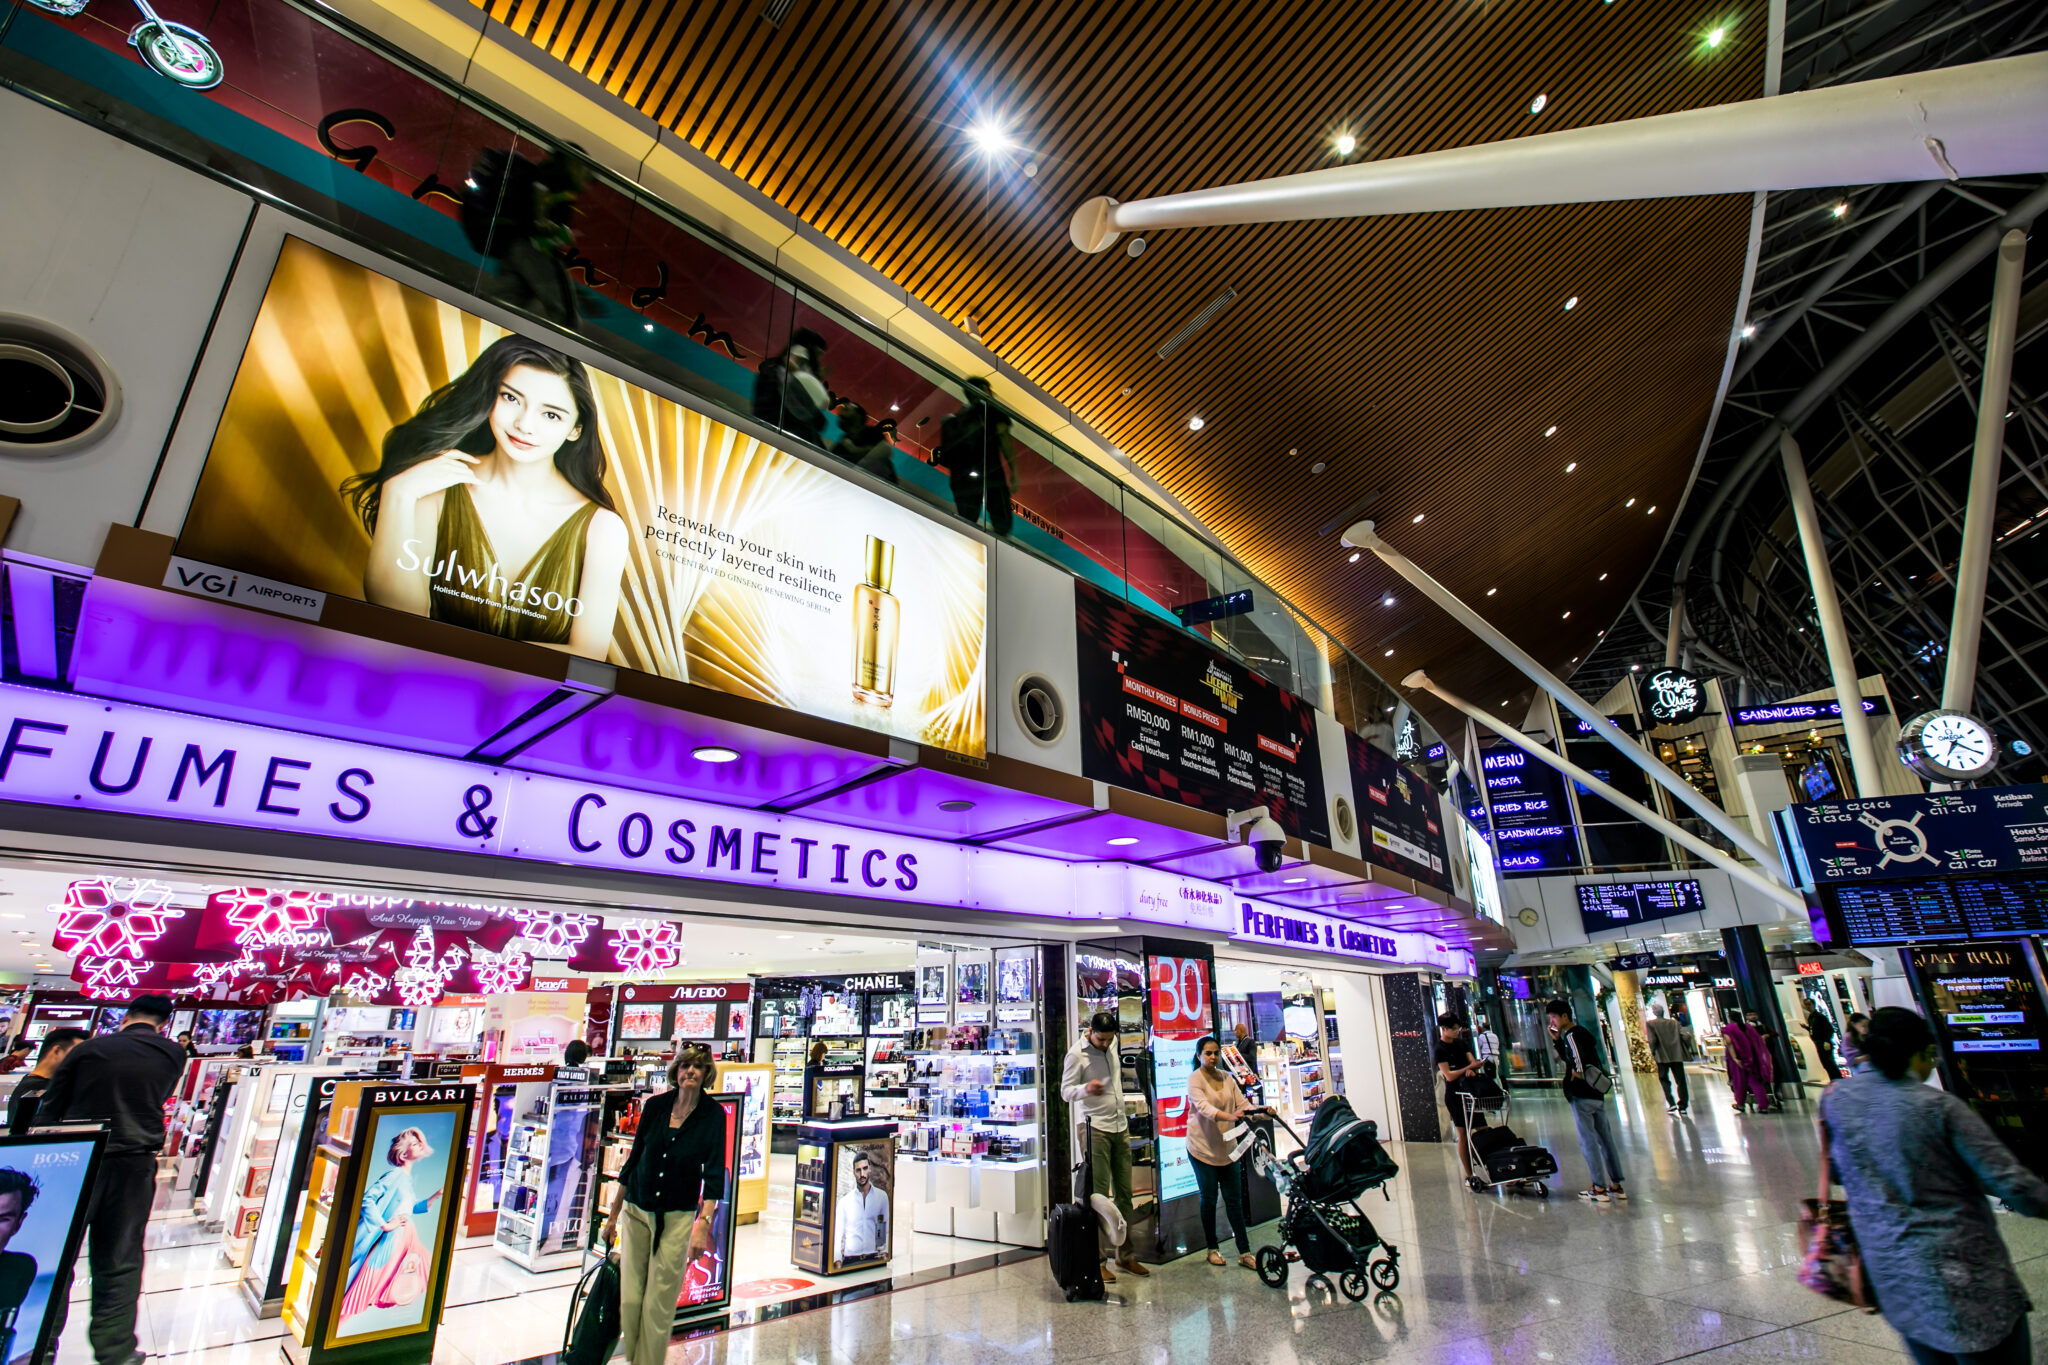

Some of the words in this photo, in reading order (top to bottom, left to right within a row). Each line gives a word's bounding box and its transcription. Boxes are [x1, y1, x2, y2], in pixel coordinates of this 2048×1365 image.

[1023, 507, 1064, 539] Malaysia
[657, 505, 735, 545] Reawaken
[740, 538, 773, 558] your
[776, 551, 804, 570] skin
[809, 564, 836, 583] with
[645, 524, 717, 560] perfectly
[722, 548, 774, 579] layered
[779, 571, 842, 603] resilience
[396, 539, 585, 617] Sulwhasoo
[655, 549, 726, 578] CONCENTRATED
[727, 574, 764, 592] GINSENG
[764, 586, 805, 606] RENEWING
[806, 601, 831, 614] SERUM
[246, 584, 317, 608] AIRPORTS
[433, 584, 460, 598] Holistic
[460, 592, 485, 605] Beauty
[485, 598, 502, 608] from
[502, 603, 521, 614] Asian
[521, 606, 548, 620] Wisdom
[1206, 672, 1234, 693] LICENCE
[1125, 678, 1156, 700] MONTHLY
[1156, 691, 1176, 708] PRIZES
[1220, 690, 1238, 710] WIN
[1126, 704, 1170, 732] RM50,000
[1183, 703, 1202, 718] BONUS
[1202, 711, 1220, 726] PRIZES
[1739, 706, 1817, 721] SANDWICHES
[1140, 732, 1160, 748] Eraman
[1182, 725, 1214, 748] RM1,000
[1938, 734, 1965, 742] OMEGA
[1131, 740, 1145, 752] Cash
[1145, 744, 1170, 760] Vouchers
[1184, 748, 1198, 759] Boost
[1224, 742, 1253, 764] RM1,000
[1180, 756, 1201, 772] Vouchers
[1201, 764, 1220, 780] monthly
[1484, 753, 1524, 768] MENU
[1488, 776, 1522, 788] PASTA
[0, 716, 375, 823] FUMES
[455, 783, 500, 840] &
[568, 792, 920, 892] COSMETICS
[1993, 794, 2034, 802] Ketibaan
[1996, 800, 2024, 808] Arrivals
[1493, 803, 1522, 814] FRIED
[1524, 800, 1549, 811] RICE
[1846, 803, 1860, 811] C2
[1862, 802, 1876, 810] C4
[1878, 801, 1892, 809] C6
[1930, 806, 1949, 816] C11
[1958, 805, 1977, 814] C17
[1808, 816, 1821, 824] C1
[1823, 815, 1837, 823] C3
[1838, 814, 1852, 822] C5
[1498, 826, 1563, 840] SANDWICHES
[2010, 827, 2036, 836] Hotel
[2018, 847, 2042, 856] Balai
[1502, 856, 1540, 867] SALAD
[1948, 861, 1968, 869] C21
[1978, 860, 1998, 868] C27
[1826, 868, 1844, 877] C31
[1854, 866, 1872, 875] C37
[1140, 890, 1156, 910] duty
[1156, 892, 1168, 912] free
[370, 914, 394, 924] And
[396, 914, 430, 926] Happy
[432, 915, 456, 925] New
[458, 916, 482, 927] Year
[1242, 902, 1319, 945] PERFUMES
[1324, 924, 1335, 948] &
[1338, 923, 1397, 957] COSMETICS
[294, 950, 312, 958] And
[314, 950, 338, 959] Happy
[340, 950, 358, 958] New
[1800, 962, 1824, 974] CHANEL
[534, 978, 569, 991] benefit
[844, 976, 903, 990] CHANEL
[1656, 975, 1684, 984] ARMANI
[1936, 978, 1957, 986] Spend
[670, 986, 727, 999] SHISEIDO
[1157, 956, 1203, 1021] 30
[374, 1088, 465, 1103] BVLGARI
[33, 1151, 80, 1165] BOSS
[548, 1218, 584, 1235] POLO
